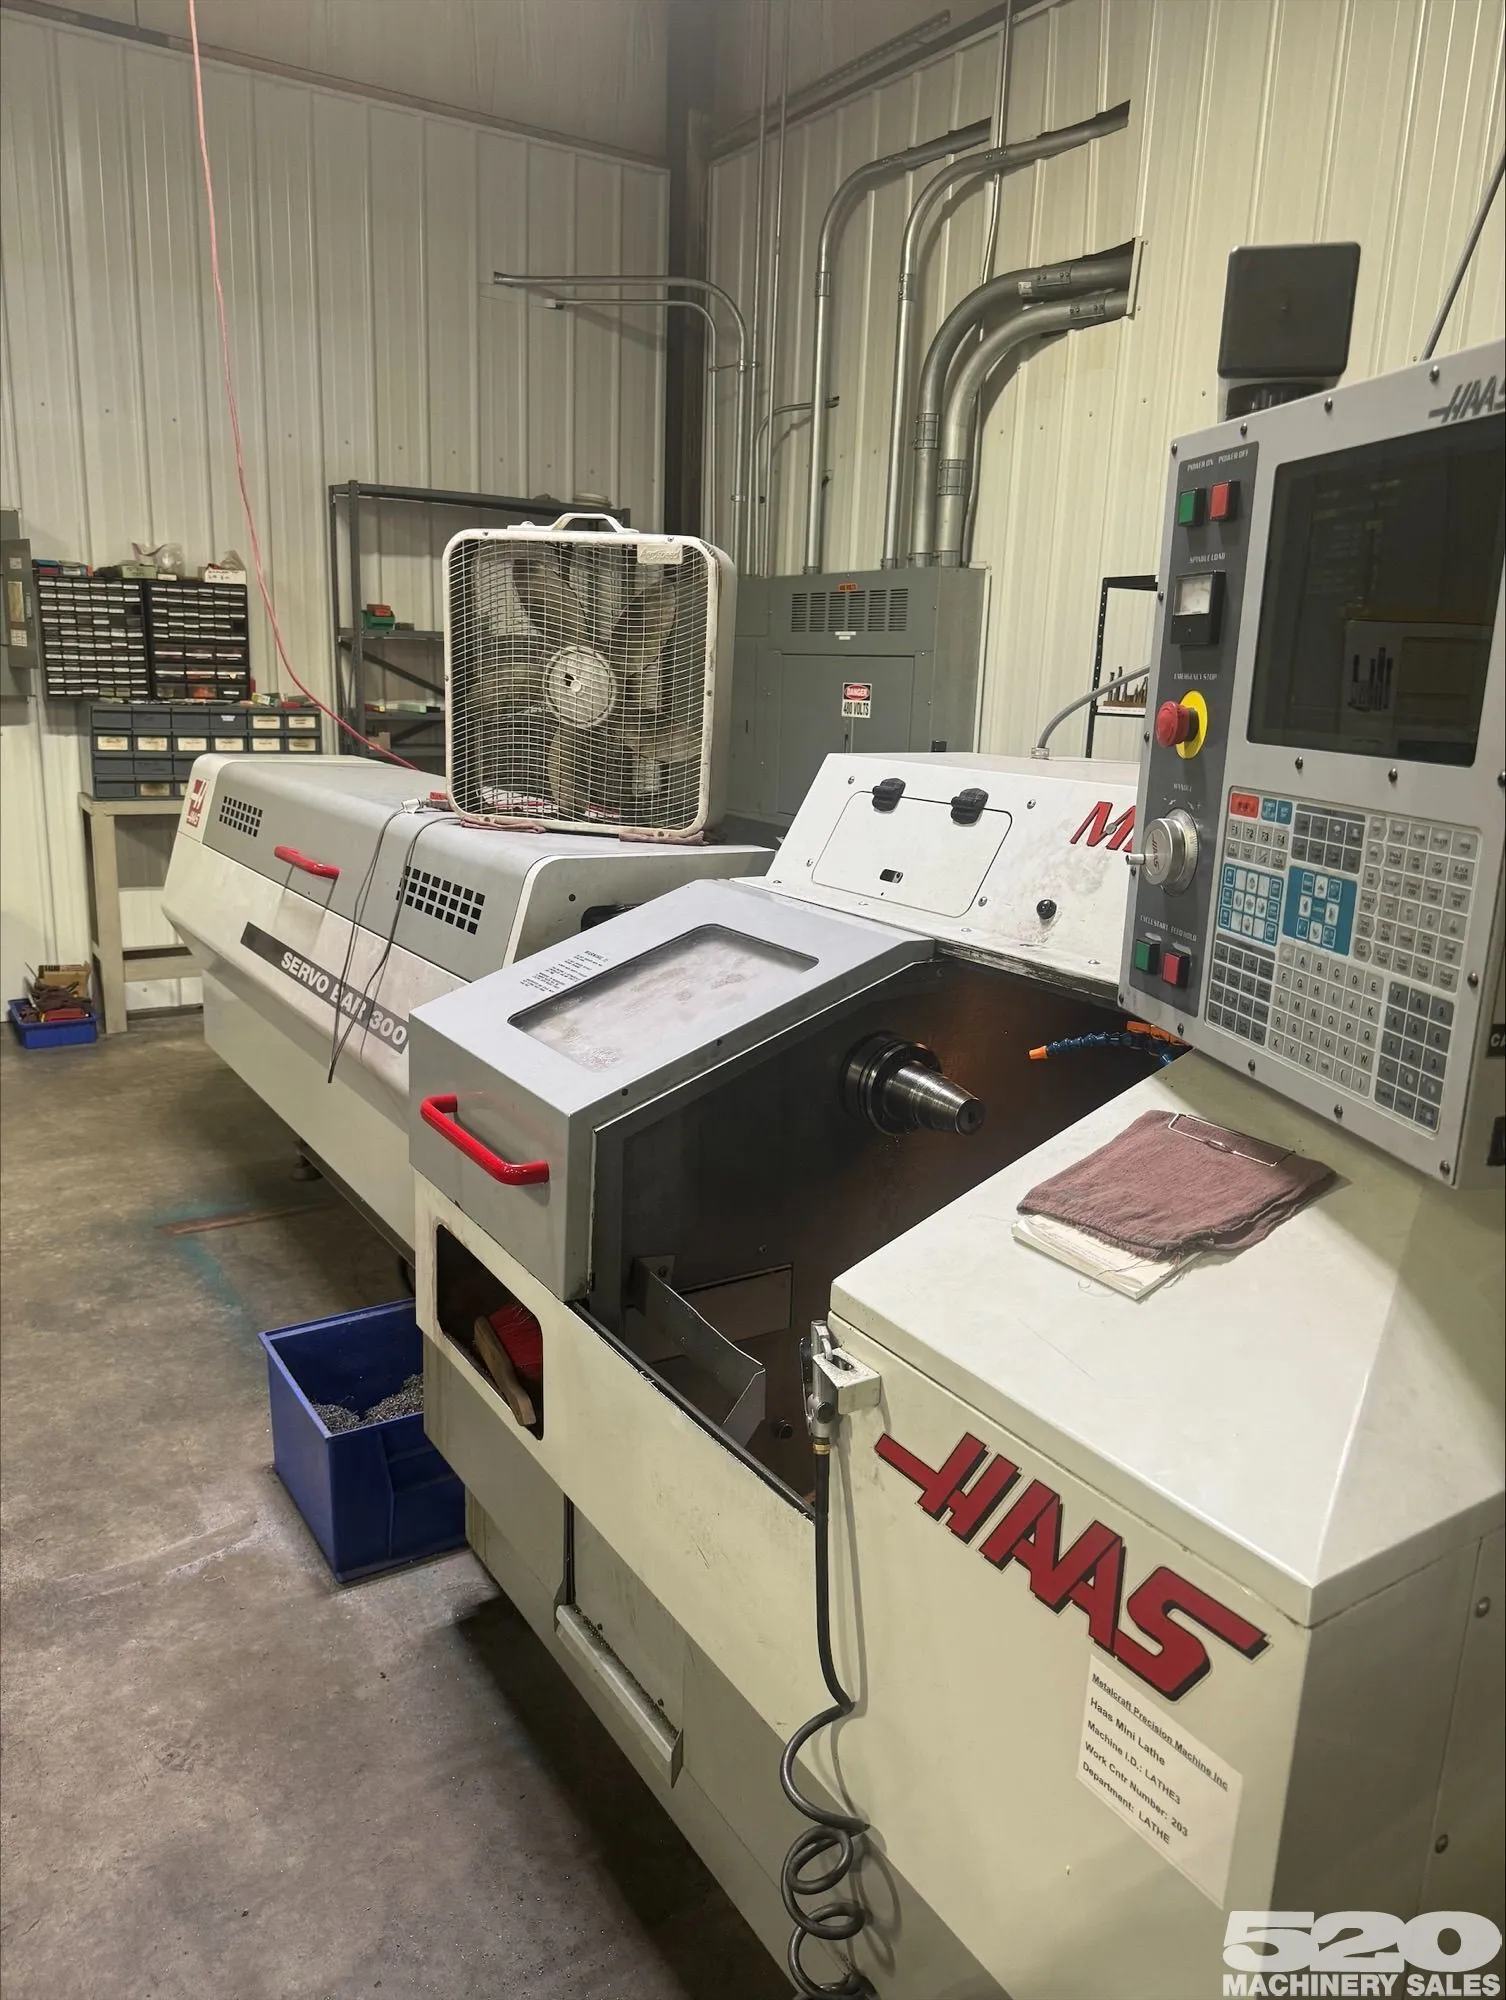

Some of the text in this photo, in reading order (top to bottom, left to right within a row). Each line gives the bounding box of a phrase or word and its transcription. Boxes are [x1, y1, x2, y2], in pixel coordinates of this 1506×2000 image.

[853, 702, 869, 716] VOLTS
[1232, 824, 1284, 844] F1 F2 F3 F4
[1282, 973, 1286, 982] F
[1297, 979, 1303, 988] G
[1314, 986, 1320, 995] H
[1350, 998, 1354, 1008] J
[1368, 1006, 1373, 1016] K
[1300, 957, 1305, 966] A
[1317, 962, 1322, 972] B
[1334, 969, 1340, 978] C
[1371, 982, 1376, 991] E
[1396, 990, 1400, 1000] 7
[281, 952, 329, 993] SERVO
[368, 1010, 407, 1045] 300
[1279, 995, 1282, 1003] L
[1295, 1001, 1300, 1010] M
[1311, 1008, 1316, 1018] N
[1346, 1023, 1351, 1032] P
[1274, 1038, 1278, 1048] X
[1290, 1046, 1295, 1054] Y
[1305, 1053, 1310, 1062] Z
[1276, 1016, 1281, 1025] R
[1292, 1024, 1297, 1032] S
[1309, 1031, 1314, 1040] T
[1343, 1046, 1349, 1056] V
[1360, 1054, 1368, 1064] W
[875, 1432, 1270, 1701] HAAS
[1090, 1698, 1165, 1766] Haas Mini Lathe
[1092, 1673, 1228, 1790] Metalcraft Precision Machine Inc
[1088, 1720, 1123, 1755] Machine
[1145, 1770, 1180, 1804] LATHE3
[1082, 1761, 1170, 1844] Department: LATHE
[1085, 1742, 1188, 1836] Work Cntr Number: 203
